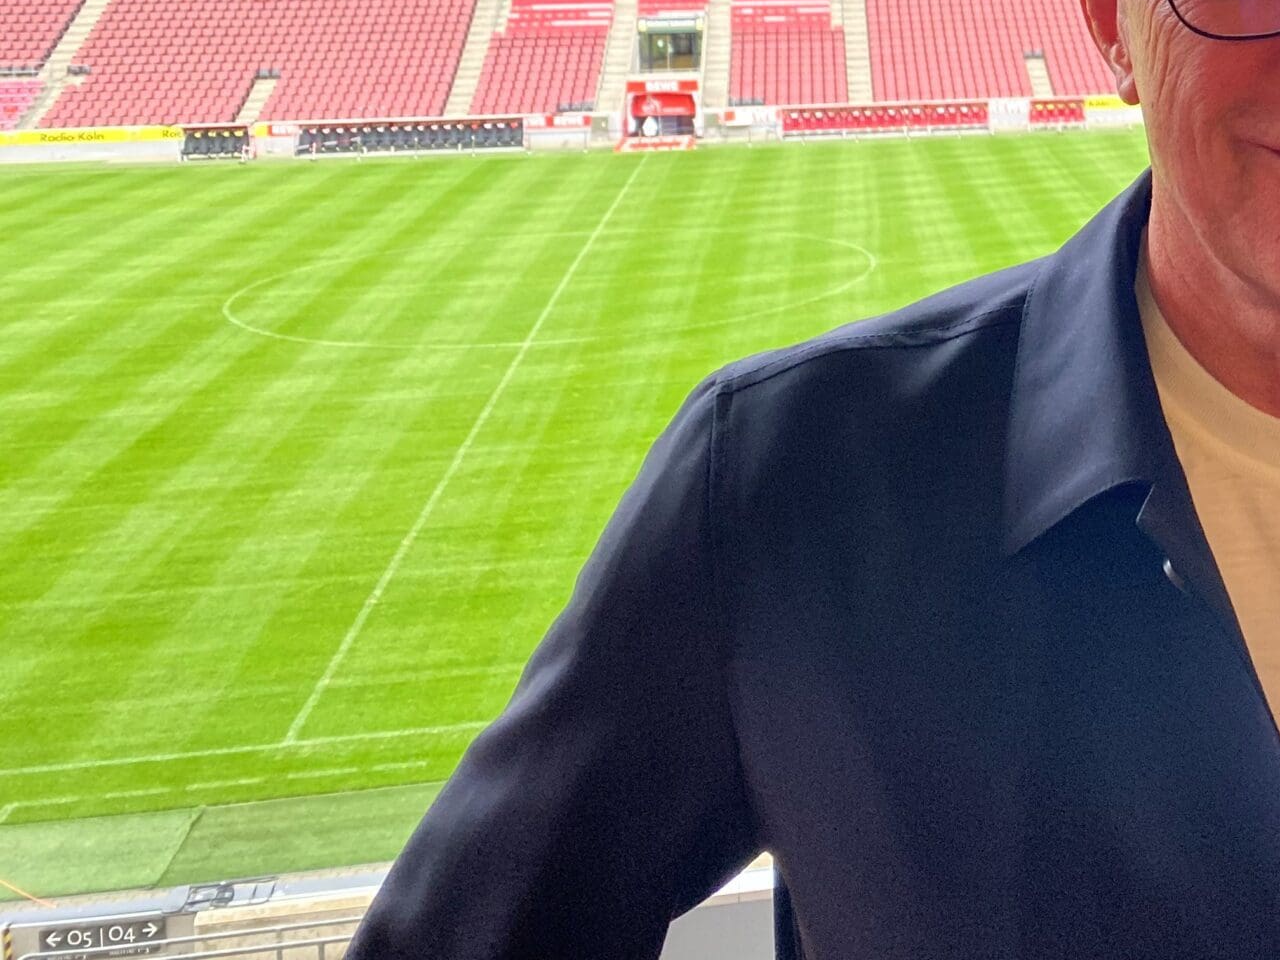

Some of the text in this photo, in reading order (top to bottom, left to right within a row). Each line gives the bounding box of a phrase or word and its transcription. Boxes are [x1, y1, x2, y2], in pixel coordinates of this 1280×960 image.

[40, 133, 75, 142] Radio
[67, 926, 136, 948] 05 04
